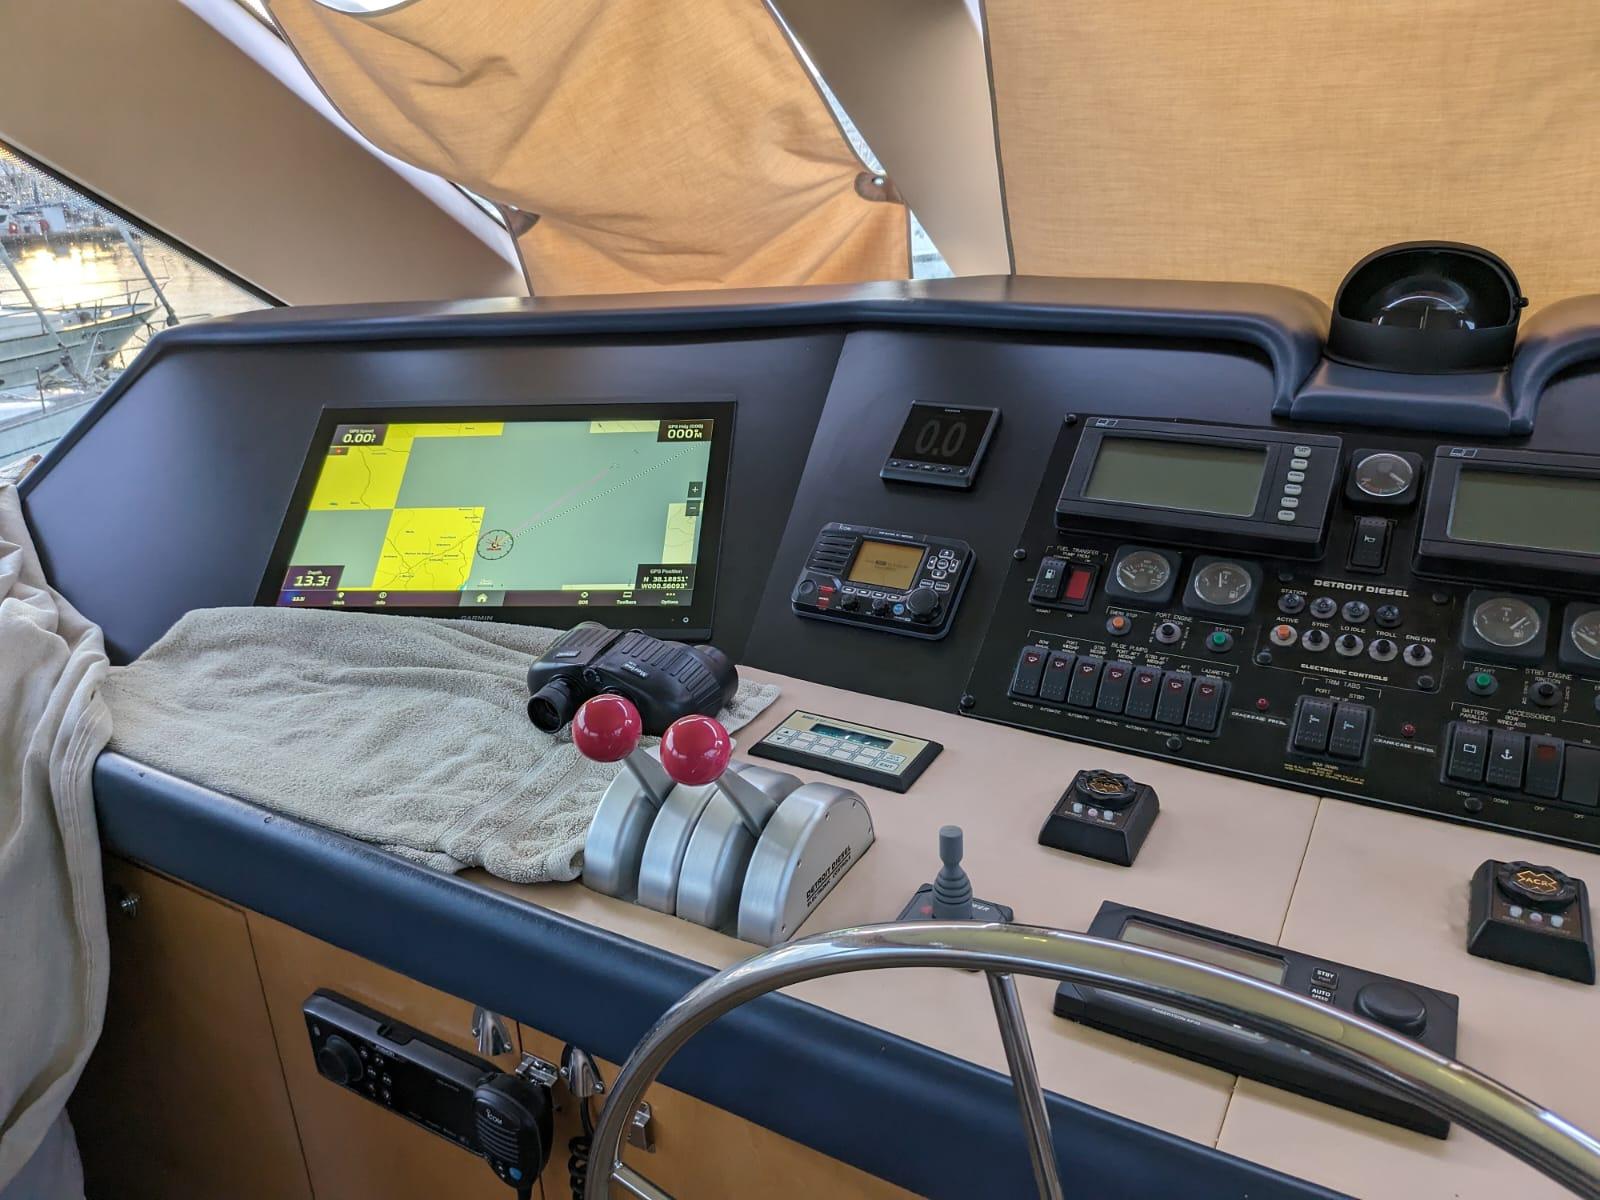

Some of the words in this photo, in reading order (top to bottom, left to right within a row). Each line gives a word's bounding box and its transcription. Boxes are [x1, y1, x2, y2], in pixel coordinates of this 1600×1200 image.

[915, 420, 967, 457] 0.0
[1280, 588, 1308, 597] STATION
[1313, 579, 1364, 593] DETROIT
[1366, 585, 1410, 598] DIESEL
[1173, 615, 1193, 623] ENGINE
[1276, 616, 1300, 624] ACTIVE
[1311, 621, 1330, 629] SYNC
[1350, 626, 1367, 634] IDLE
[1375, 630, 1397, 639] TROLL
[1405, 634, 1421, 642] ENG
[1421, 636, 1437, 644] OVR
[1301, 663, 1346, 675] ELECTRONIC
[1348, 671, 1389, 682] CONTROLS
[1474, 666, 1496, 674] START
[1525, 668, 1544, 676] STBD
[1547, 671, 1573, 681] ENGINE
[1325, 678, 1340, 686] TRIM
[1343, 681, 1361, 690] TABS
[1315, 687, 1331, 695] PORT
[1461, 707, 1489, 716] BATTERY
[1459, 713, 1489, 722] PARALLEL
[806, 866, 831, 899] DETROIT
[831, 844, 851, 870] DIESEL
[1526, 877, 1549, 887] ACR
[1317, 969, 1335, 979] STBY
[1311, 988, 1331, 997] AUTO
